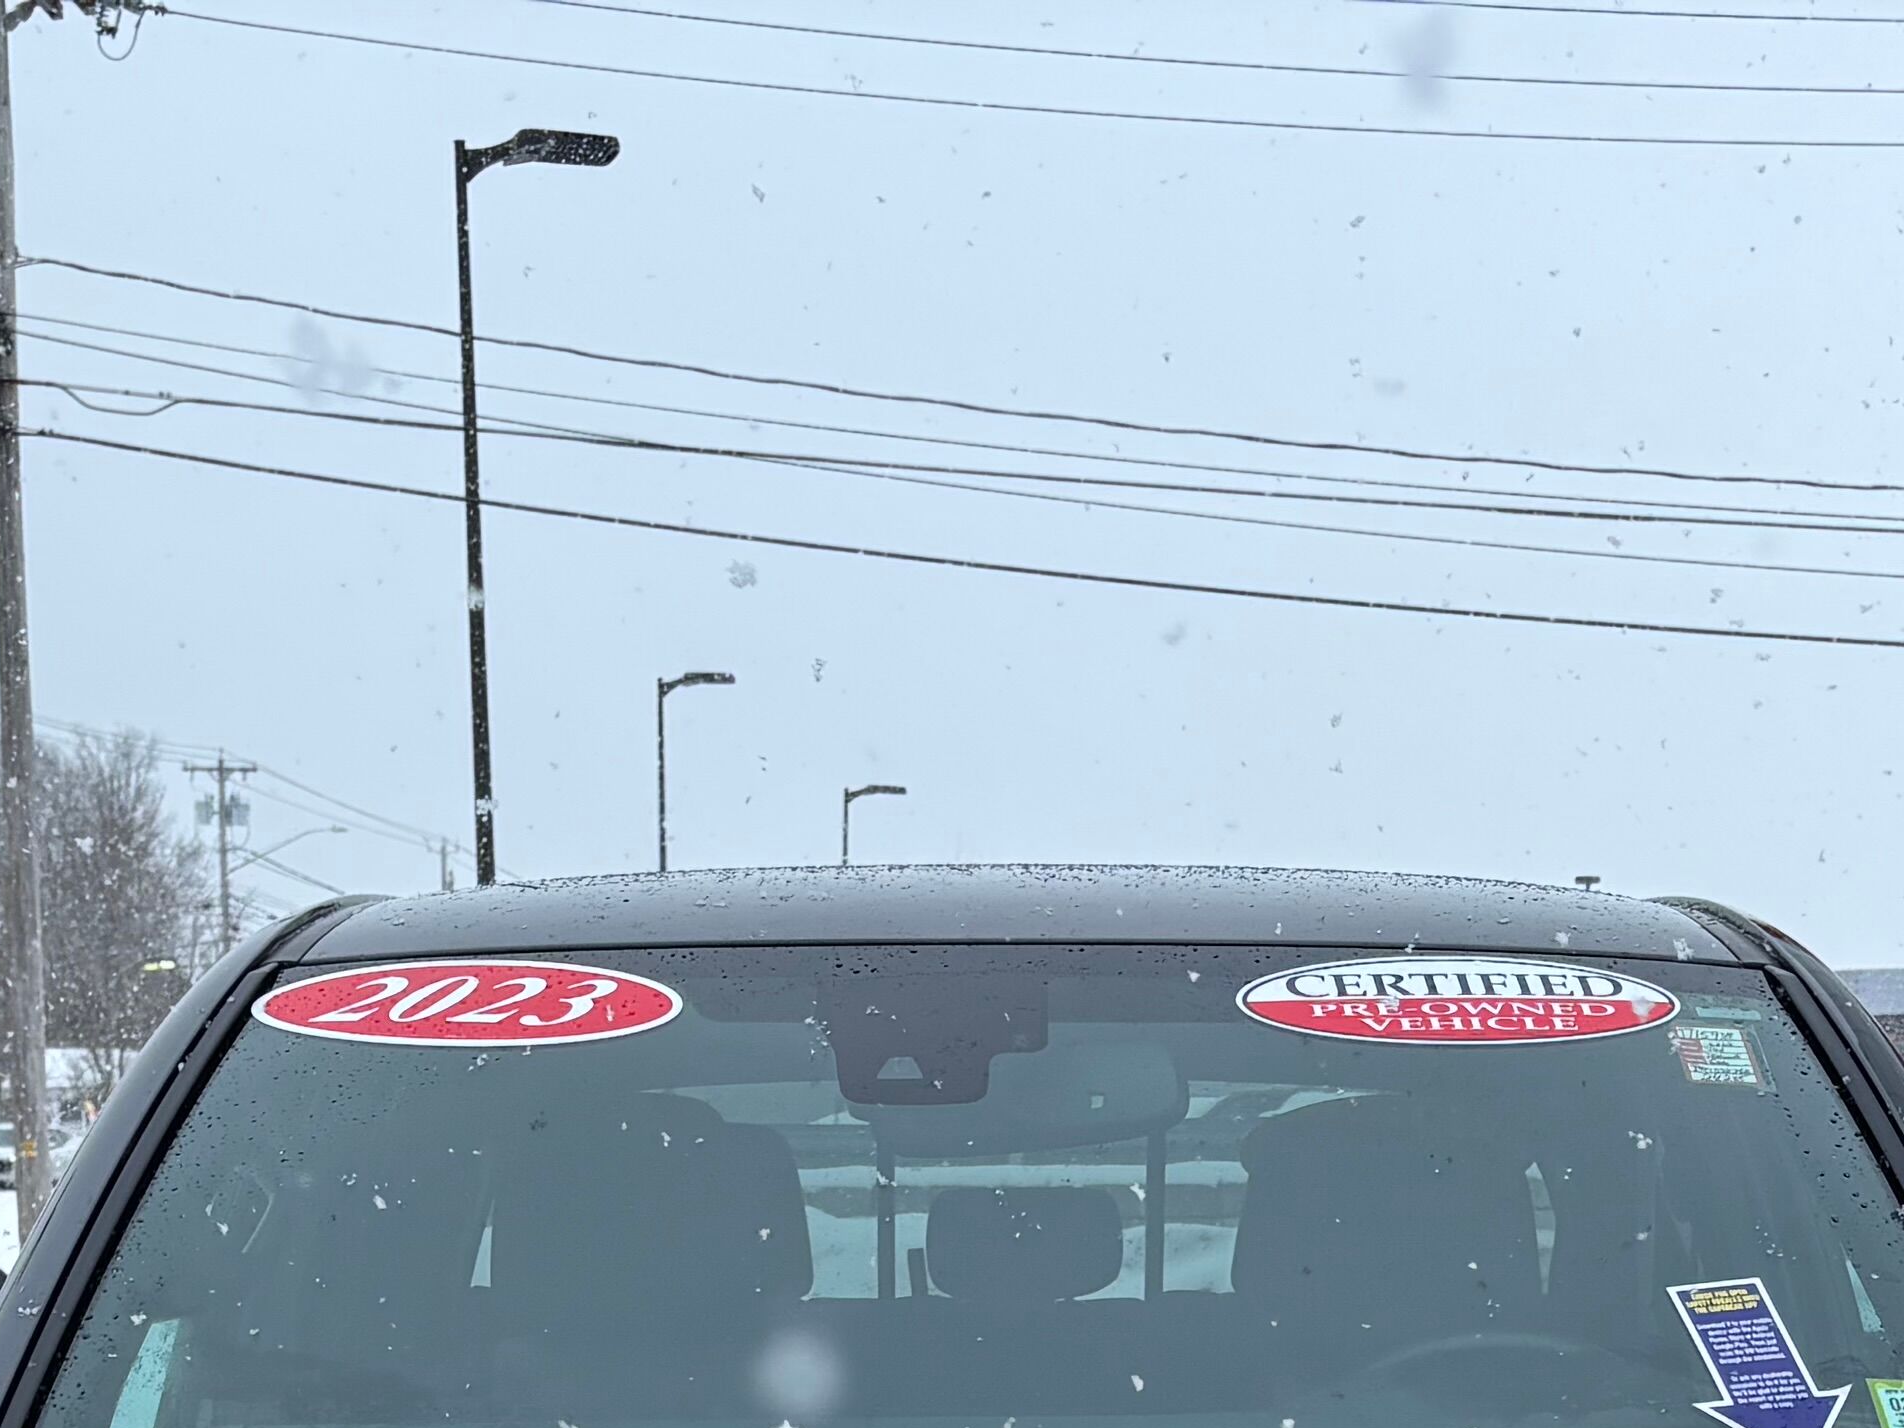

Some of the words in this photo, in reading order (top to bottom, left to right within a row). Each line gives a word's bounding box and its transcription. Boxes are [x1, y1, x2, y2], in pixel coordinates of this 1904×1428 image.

[1286, 972, 1624, 999] CERTIFIED
[307, 975, 619, 1026] 2023
[1311, 1000, 1617, 1018] PRE-OWNED
[1360, 1016, 1579, 1032] VEHICLE
